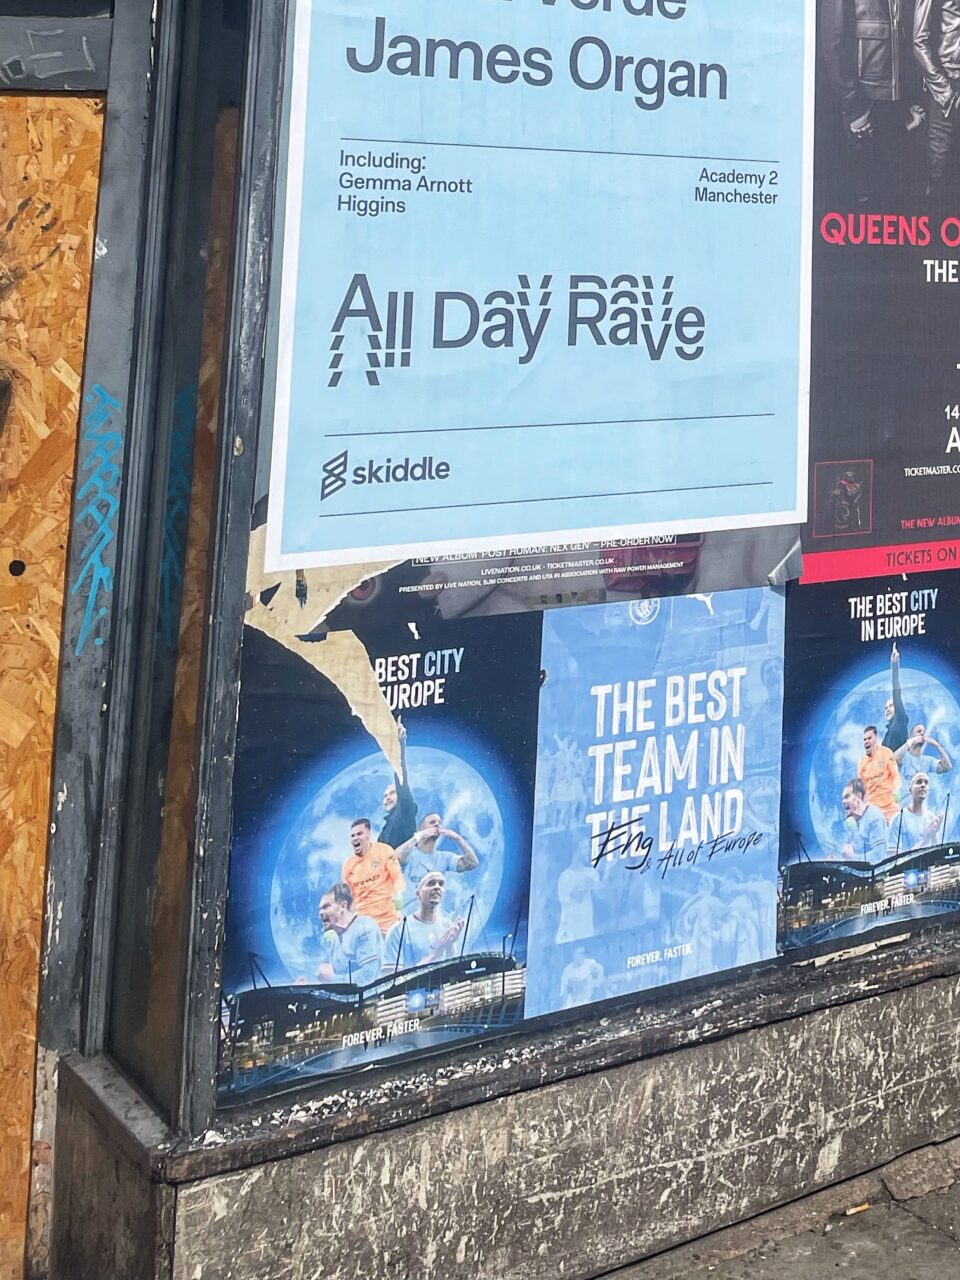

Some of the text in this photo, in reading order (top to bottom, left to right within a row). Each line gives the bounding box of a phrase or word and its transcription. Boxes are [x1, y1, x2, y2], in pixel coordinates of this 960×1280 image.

[345, 17, 728, 111] James Organ
[339, 149, 427, 172] Including:
[338, 173, 473, 194] Gemma Arnott
[698, 166, 778, 188] Academy 2
[336, 195, 406, 215] Higgins
[693, 186, 778, 205] Manchester
[821, 212, 931, 246] QUEENS
[923, 259, 959, 283] THE
[328, 273, 705, 387] All Day Rave
[944, 405, 960, 420] 14
[351, 457, 450, 484] skiddle
[901, 519, 916, 530] THE
[917, 517, 935, 528] NEW
[600, 534, 675, 549] PRE-ORDER NOW
[481, 558, 615, 576] LIVENATION.CO.UK TICKETMASTER.CO.UK
[886, 549, 932, 567] TICKETS
[937, 547, 957, 562] ON
[848, 588, 938, 620] THE BEST CITY
[861, 612, 926, 641] IN EUROPE
[374, 647, 464, 683] BEST CITY
[590, 667, 747, 738] THE BEST
[587, 723, 746, 805] TEAM IN
[658, 788, 744, 852] LAND
[702, 831, 763, 861] Europe
[627, 950, 663, 969] FOREVER.
[342, 1018, 423, 1049] FOREVER. FASTER.
